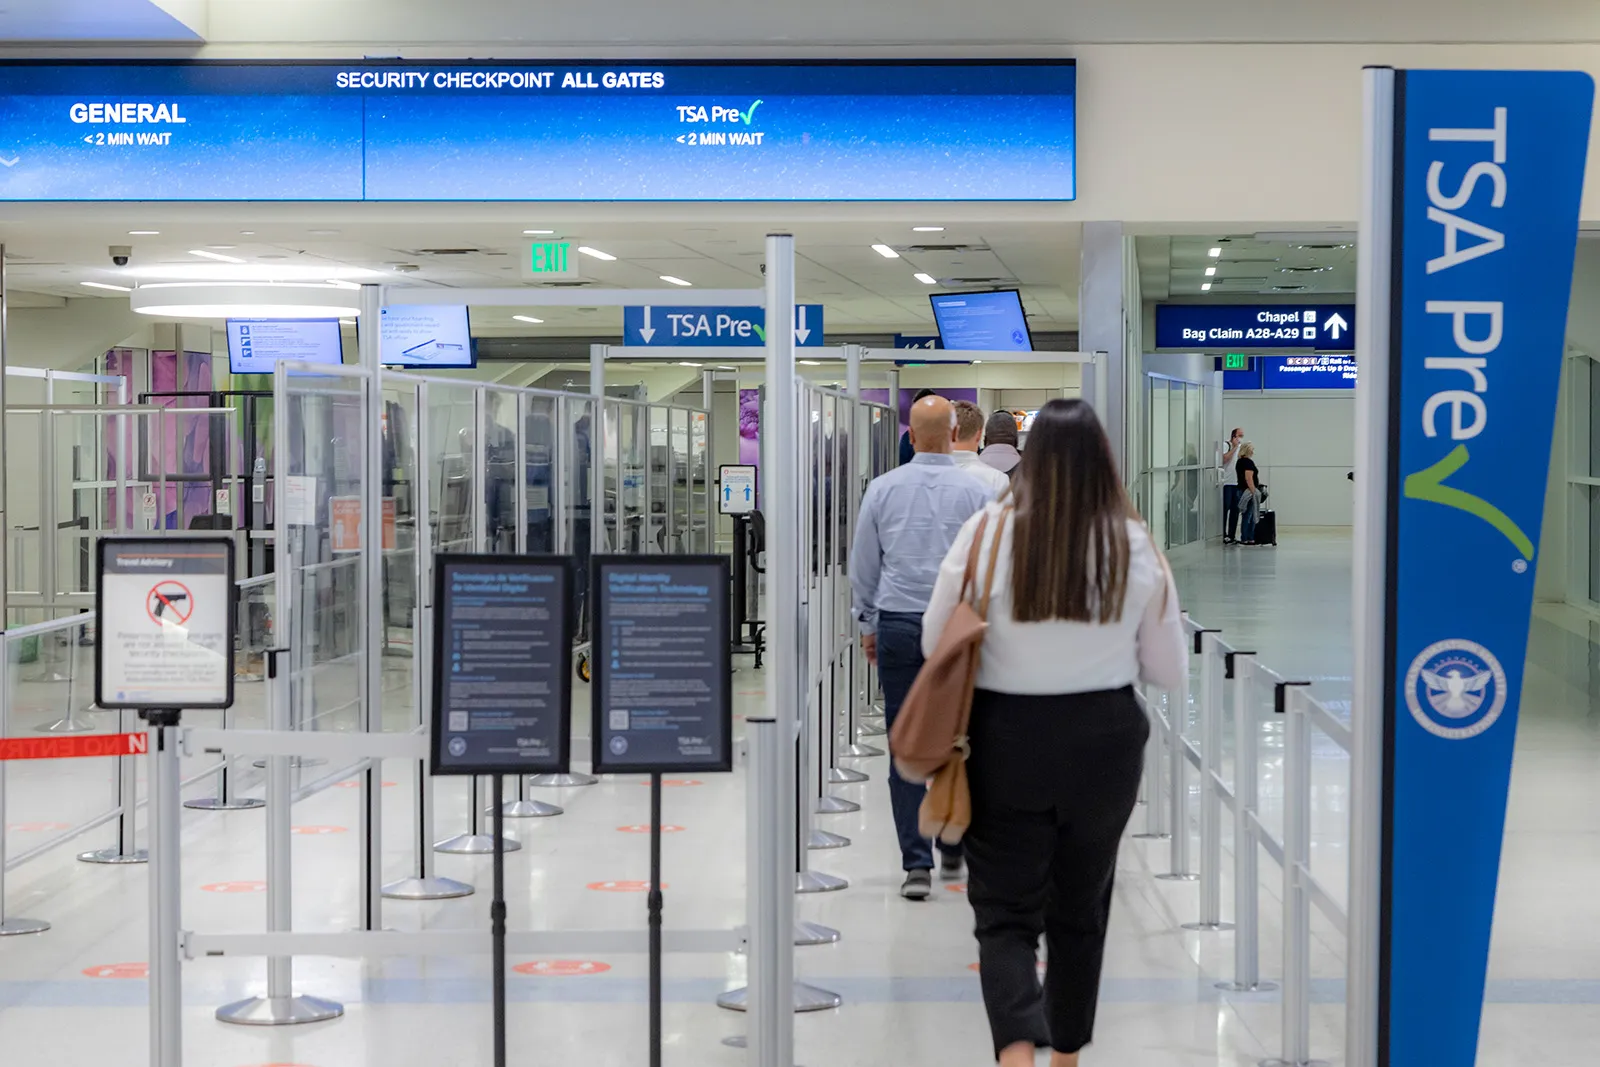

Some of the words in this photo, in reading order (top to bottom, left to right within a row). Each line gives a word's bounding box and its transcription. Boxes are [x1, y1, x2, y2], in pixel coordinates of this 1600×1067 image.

[336, 72, 429, 89] SECURITY
[433, 72, 554, 89] CHECKPOINT
[561, 72, 599, 88] ALL
[602, 72, 665, 89] GATES
[69, 103, 187, 123] GENERAL
[676, 105, 709, 123] TSA
[95, 132, 105, 145] 2
[107, 132, 134, 145] MIN
[136, 132, 172, 145] WAIT
[688, 132, 697, 145] 2
[699, 132, 726, 145] MIN
[728, 132, 765, 145] WAIT
[1426, 106, 1507, 275] TSA
[531, 243, 570, 272] EXIT
[667, 314, 712, 337] TSA
[1257, 311, 1300, 325] Chapel
[1182, 328, 1206, 341] Bag
[1209, 328, 1243, 339] Claim
[1246, 328, 1300, 339] A28-A29
[1226, 354, 1245, 368] EXIT
[1279, 365, 1312, 373] Passenger
[1327, 365, 1337, 373] Up
